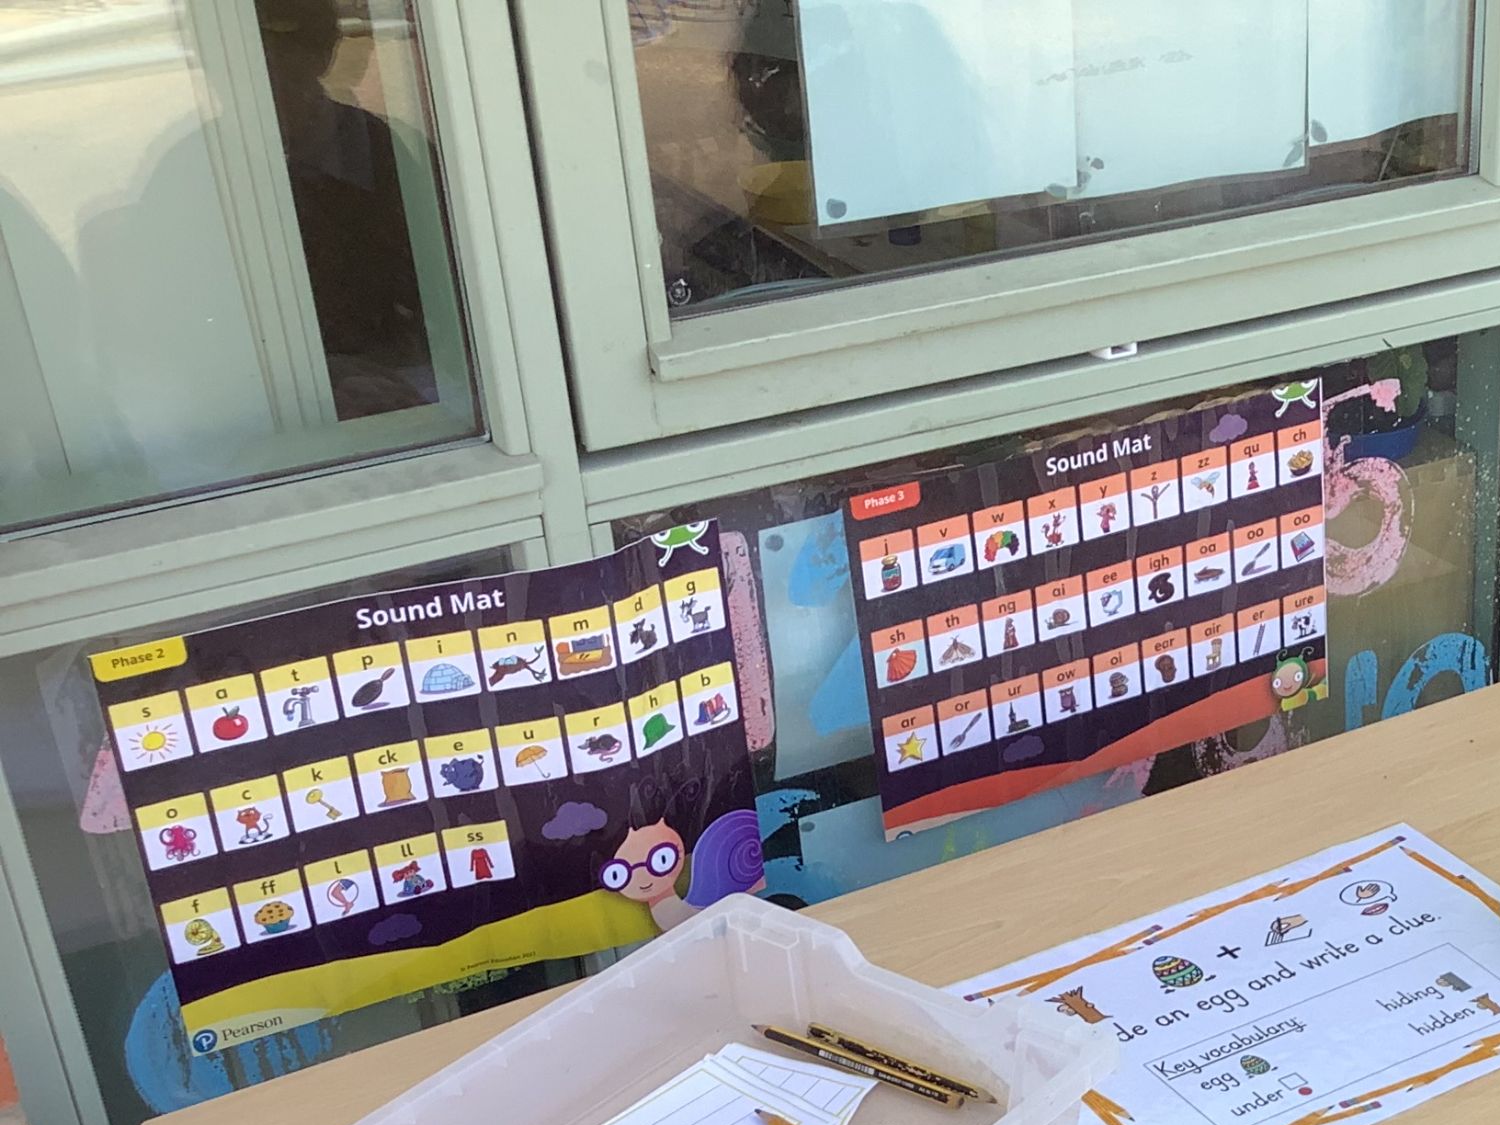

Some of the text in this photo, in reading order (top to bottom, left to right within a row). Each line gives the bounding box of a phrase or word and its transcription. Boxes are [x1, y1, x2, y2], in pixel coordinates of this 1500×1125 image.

[1045, 434, 1152, 476] Sound Mat
[864, 490, 905, 509] Phase 3
[883, 429, 1307, 556] j v w x y z zz qu ch
[889, 514, 1311, 644] sh th ng ai ee igh oa oo oo
[356, 589, 505, 630] Sound Mat
[111, 648, 165, 669] Phase 2
[141, 581, 696, 718] s a t p i n m d g
[900, 595, 1314, 729] ar or ur ow oi ear air er ure
[166, 673, 711, 819] o c k ck e u r h b
[192, 900, 200, 913] f
[260, 880, 276, 896] ff
[467, 830, 484, 842] ss
[1113, 913, 1442, 1043] de an egg and write a clue.
[1375, 985, 1445, 1012] hiding
[221, 1015, 283, 1041] Pearson
[1408, 1007, 1476, 1036] hidden
[1153, 1058, 1202, 1078] Key
[1201, 1072, 1241, 1092] egg
[1230, 1088, 1284, 1117] under
